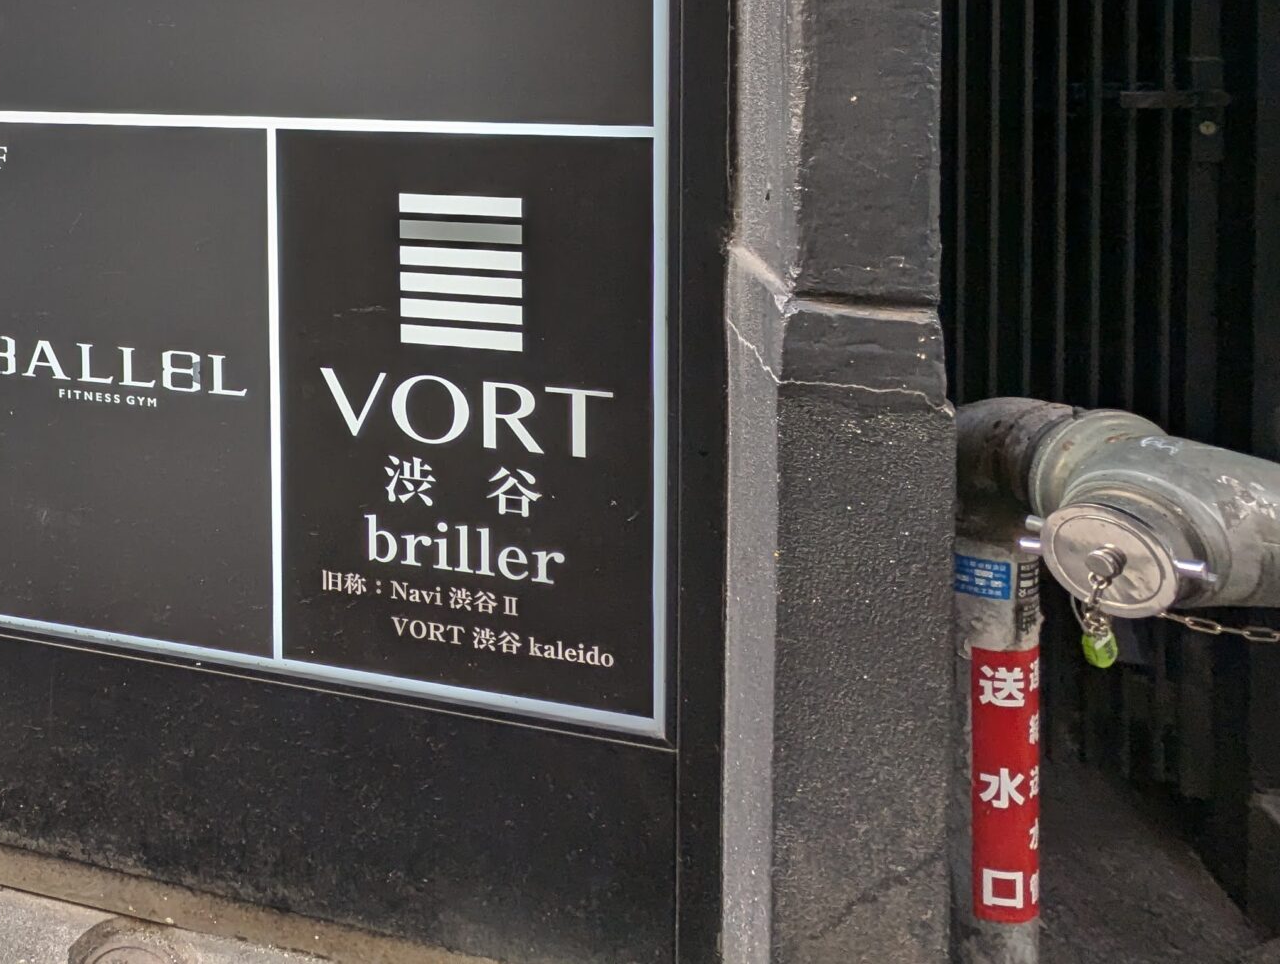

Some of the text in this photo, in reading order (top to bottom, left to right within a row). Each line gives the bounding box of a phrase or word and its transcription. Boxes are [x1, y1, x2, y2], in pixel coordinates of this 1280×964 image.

[58, 388, 158, 407] FITNESS GYM
[319, 367, 614, 458] VORT
[364, 514, 565, 585] briller
[390, 580, 441, 607] Navi
[449, 586, 498, 615] 渋谷
[392, 616, 614, 667] VORT 渋谷 kaleido
[979, 665, 1025, 909] 送水口
